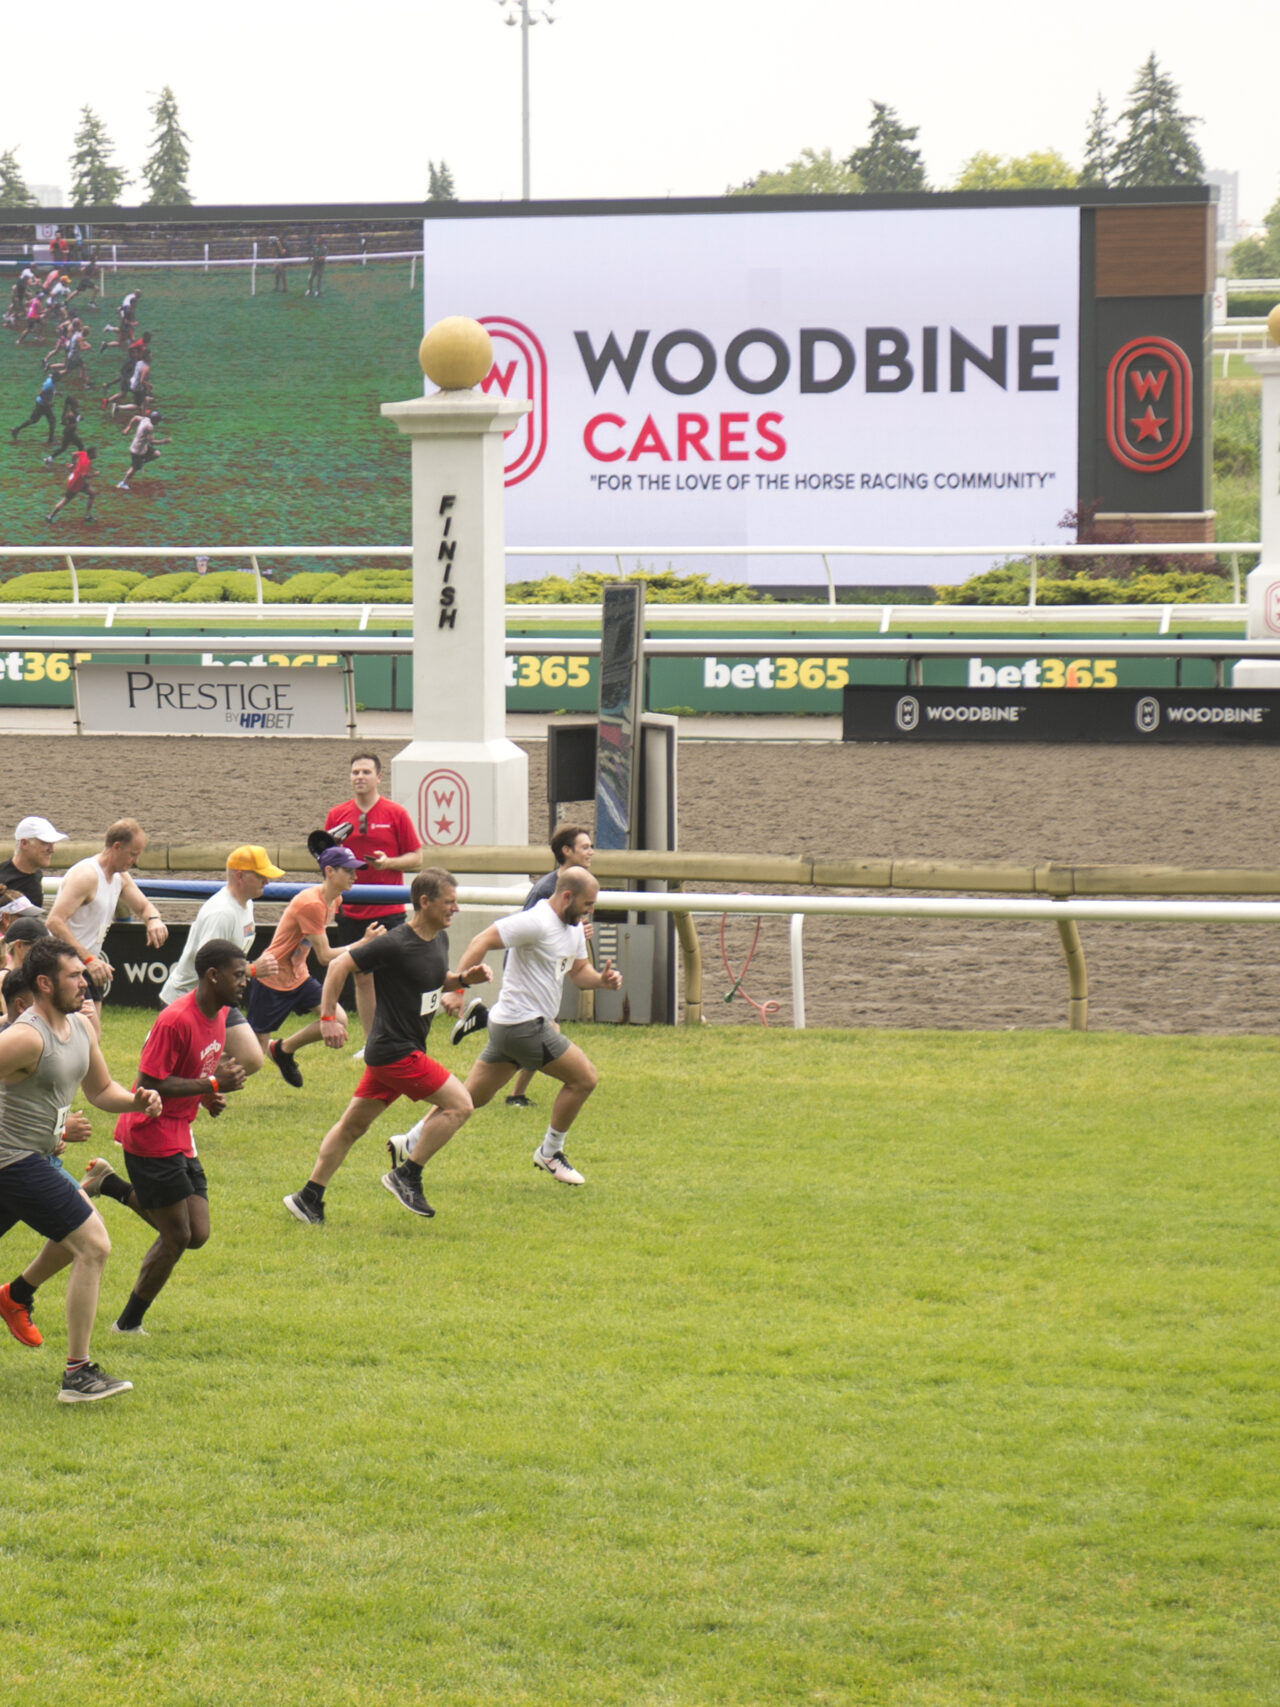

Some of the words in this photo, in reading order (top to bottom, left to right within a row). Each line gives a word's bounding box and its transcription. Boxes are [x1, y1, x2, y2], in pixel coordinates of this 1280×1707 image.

[573, 324, 1060, 396] WOODBINE
[1130, 370, 1168, 402] W
[583, 411, 787, 462] CARES
[637, 474, 670, 491] THE
[676, 474, 722, 490] LOVE
[726, 474, 751, 490] OF
[756, 473, 789, 490] THE
[795, 473, 855, 490] HORSE
[860, 473, 928, 489] RACING
[438, 495, 457, 629] FINISH
[505, 655, 591, 688] t365
[704, 657, 849, 689] bet365
[968, 658, 1118, 688] bet365
[127, 671, 294, 711] PRESTIGE
[225, 712, 239, 722] BY
[240, 713, 294, 729] HPIBET
[430, 993, 438, 1009] 9
